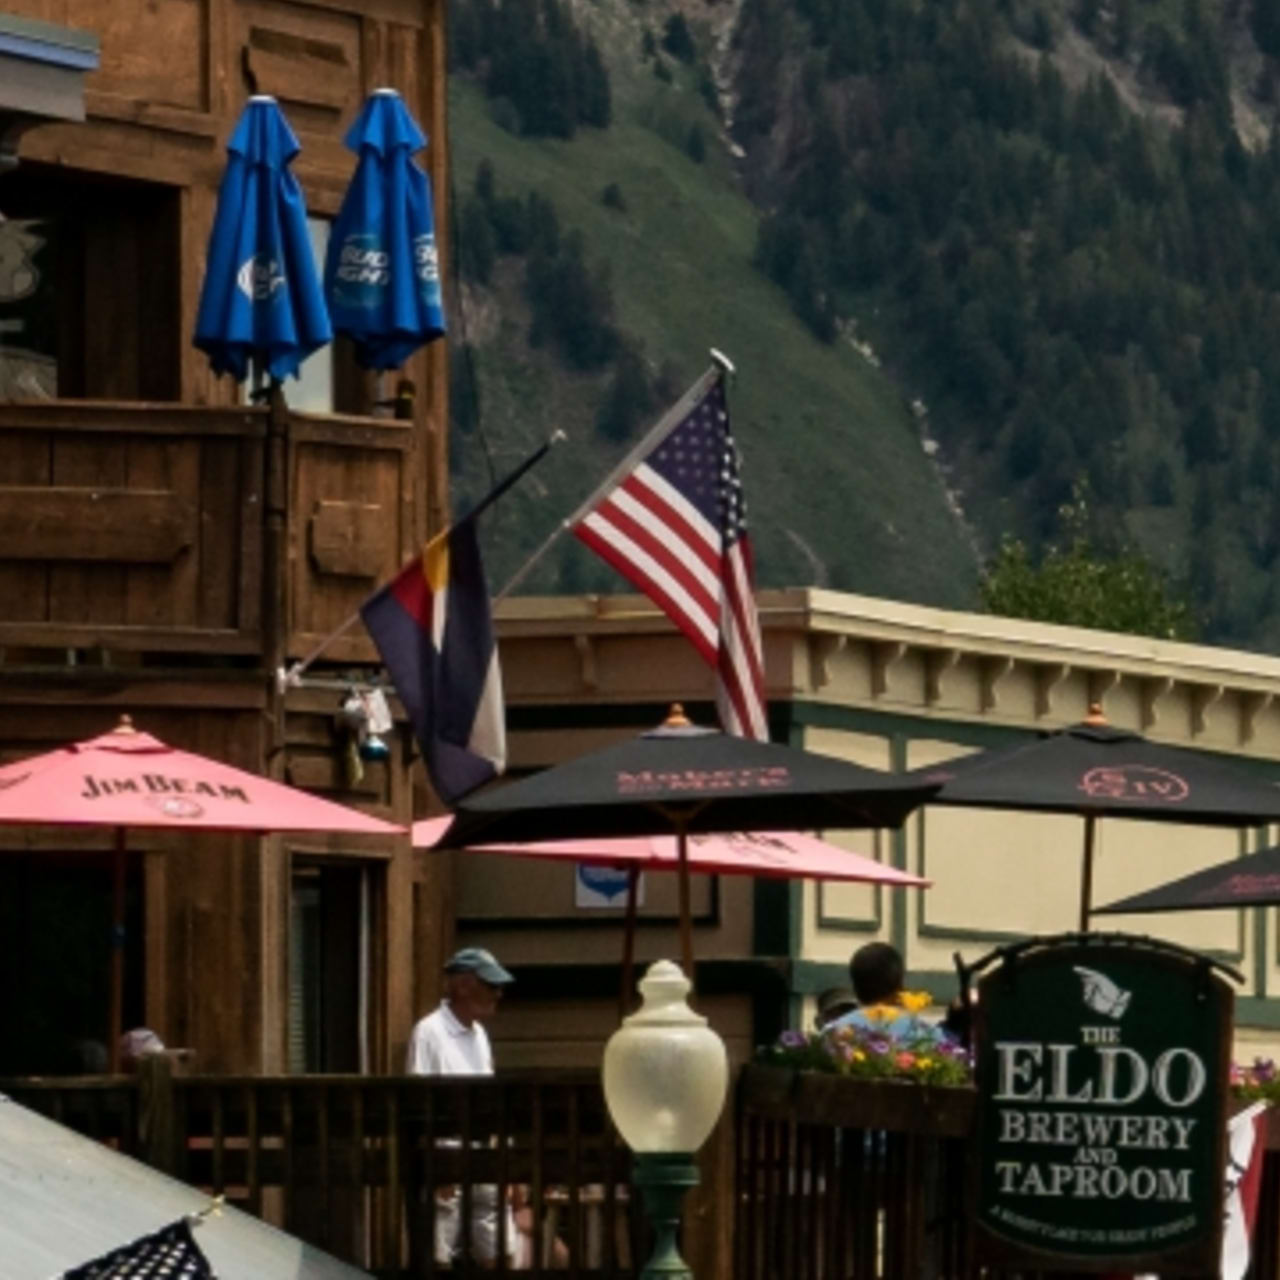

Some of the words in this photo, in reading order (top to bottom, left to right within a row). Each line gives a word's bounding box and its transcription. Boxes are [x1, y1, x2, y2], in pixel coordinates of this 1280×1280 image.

[81, 774, 138, 799] JIM
[142, 773, 250, 804] BEAM
[1080, 1026, 1121, 1044] THE
[992, 1041, 1207, 1107] ELDO
[998, 1108, 1197, 1149] BREWERY
[1073, 1146, 1117, 1166] AND
[995, 1161, 1193, 1202] TAPROOM
